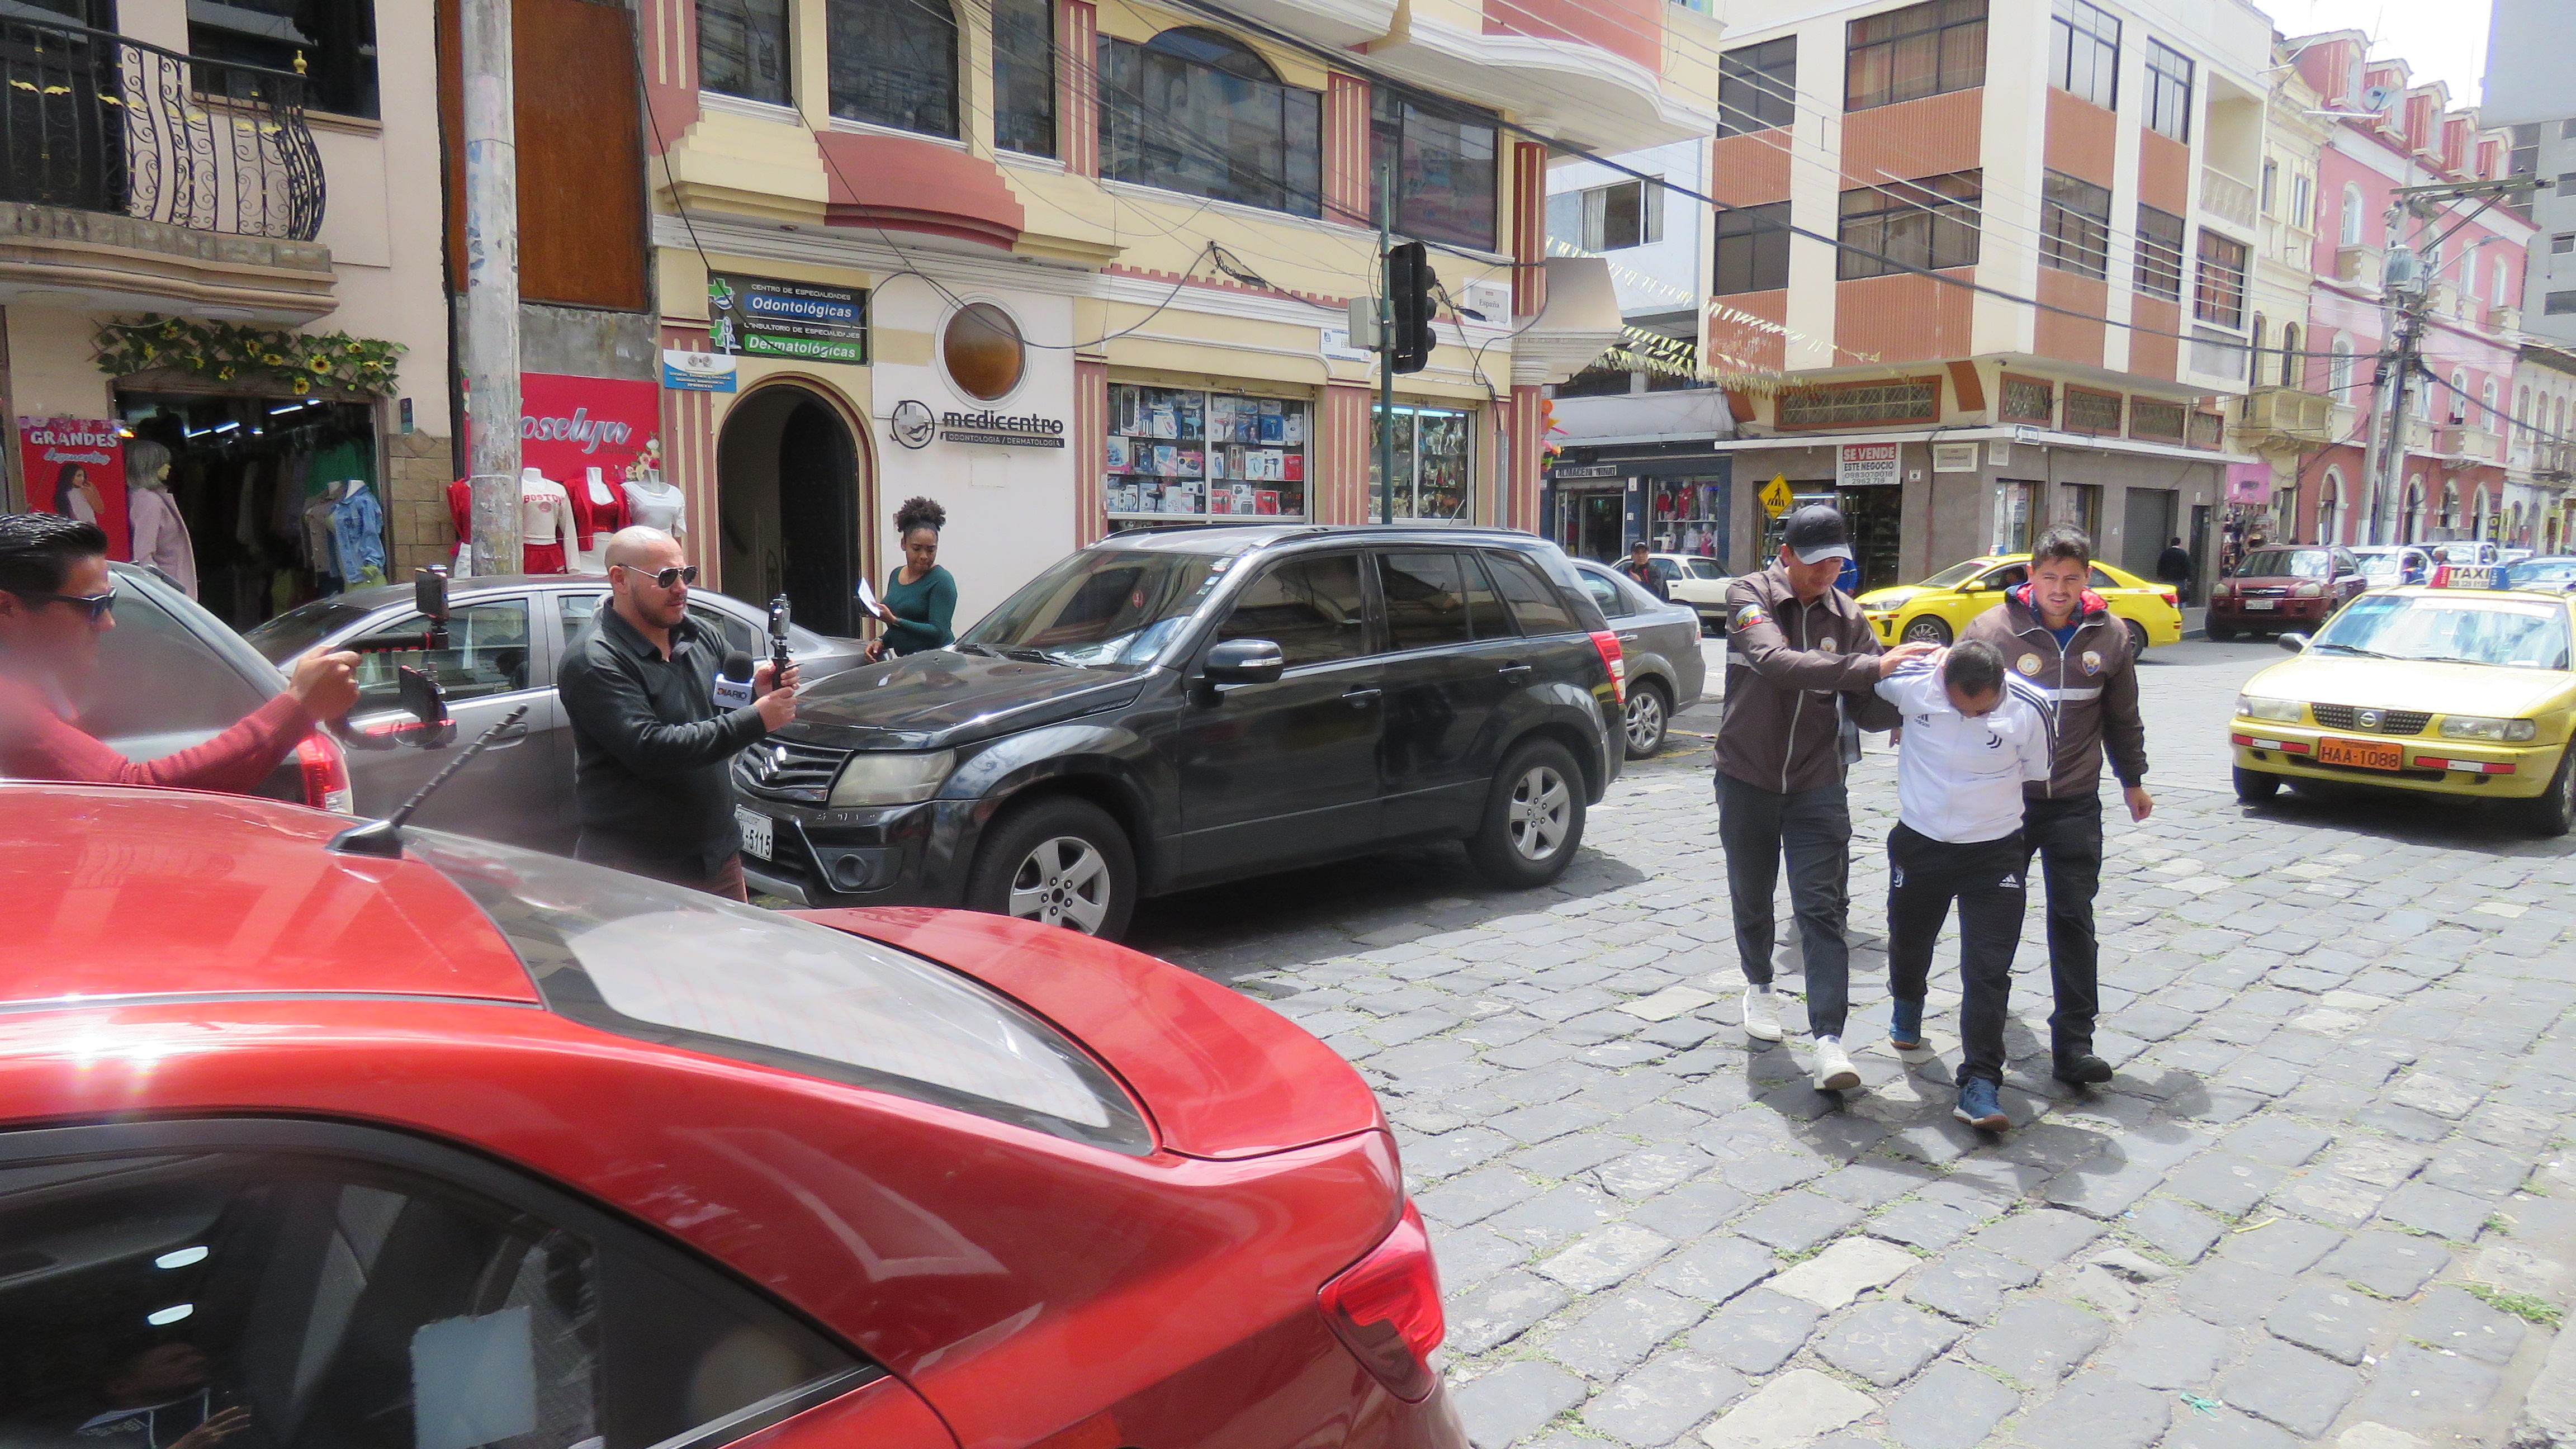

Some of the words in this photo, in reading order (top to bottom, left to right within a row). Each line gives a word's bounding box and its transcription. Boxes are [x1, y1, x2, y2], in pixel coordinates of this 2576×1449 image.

[751, 283, 780, 292] CENTRO
[795, 288, 851, 301] ESPECIALIDADES
[752, 296, 852, 318] Odontológicas
[1479, 299, 1500, 308] España
[749, 337, 856, 358] Dermatológicas
[942, 410, 1064, 434] medicentro
[30, 430, 117, 447] GRANDES
[520, 408, 632, 454] oselyn
[949, 434, 1001, 443] ODONTOLOGIA
[1844, 448, 1857, 460] SE
[1858, 446, 1895, 460] VENDE
[1844, 463, 1860, 471] ESTE
[1861, 461, 1894, 470] NEGOCIO
[2451, 567, 2489, 579] TAXI
[718, 688, 747, 699] DIARIO
[2321, 746, 2398, 768] HAA-1088
